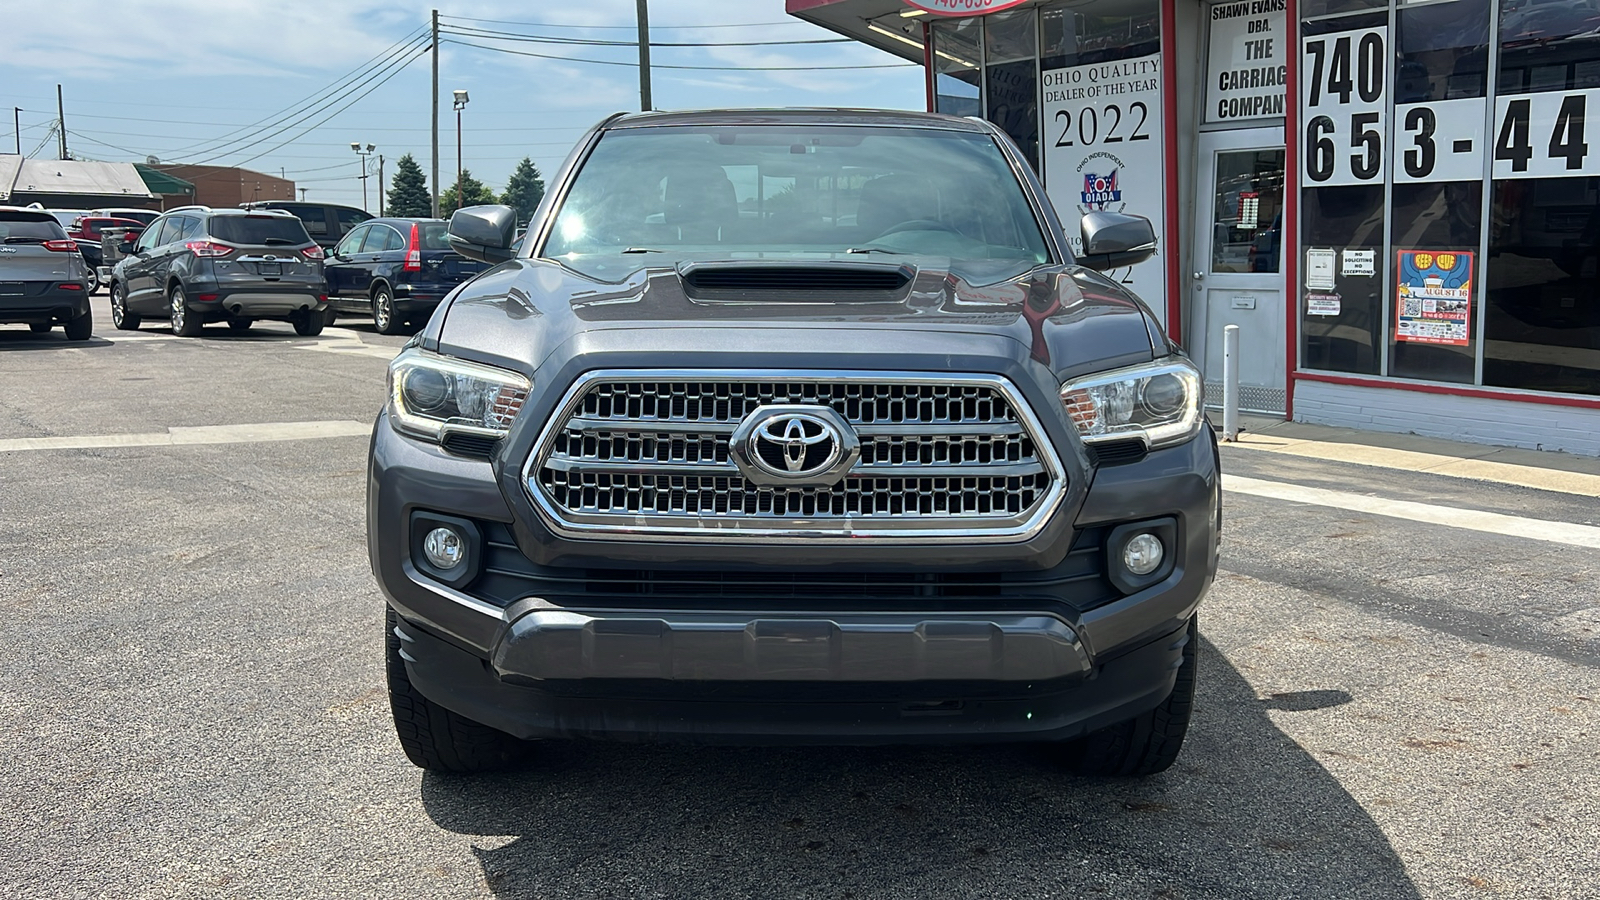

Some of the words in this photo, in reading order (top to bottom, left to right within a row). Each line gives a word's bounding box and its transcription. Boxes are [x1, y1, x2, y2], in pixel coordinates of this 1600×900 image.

[1212, 3, 1249, 20] SHAWN
[1247, 19, 1271, 34] DBA.
[1245, 38, 1273, 60] THE
[1043, 70, 1081, 86] OHIO
[1088, 59, 1159, 83] QUALITY
[1219, 65, 1287, 91] CARRIAG
[1306, 32, 1383, 107] 740
[1045, 88, 1085, 102] DEALER
[1087, 86, 1101, 97] OF
[1104, 83, 1125, 95] THE
[1128, 78, 1157, 92] YEAR
[1218, 94, 1287, 119] COMPAN
[1055, 101, 1149, 148] 2022
[1076, 157, 1089, 172] OHIO
[1088, 151, 1125, 169] INDEPENDENT
[1086, 192, 1114, 202] OIADA
[1424, 288, 1456, 296] AUGUST
[1458, 289, 1468, 297] 16
